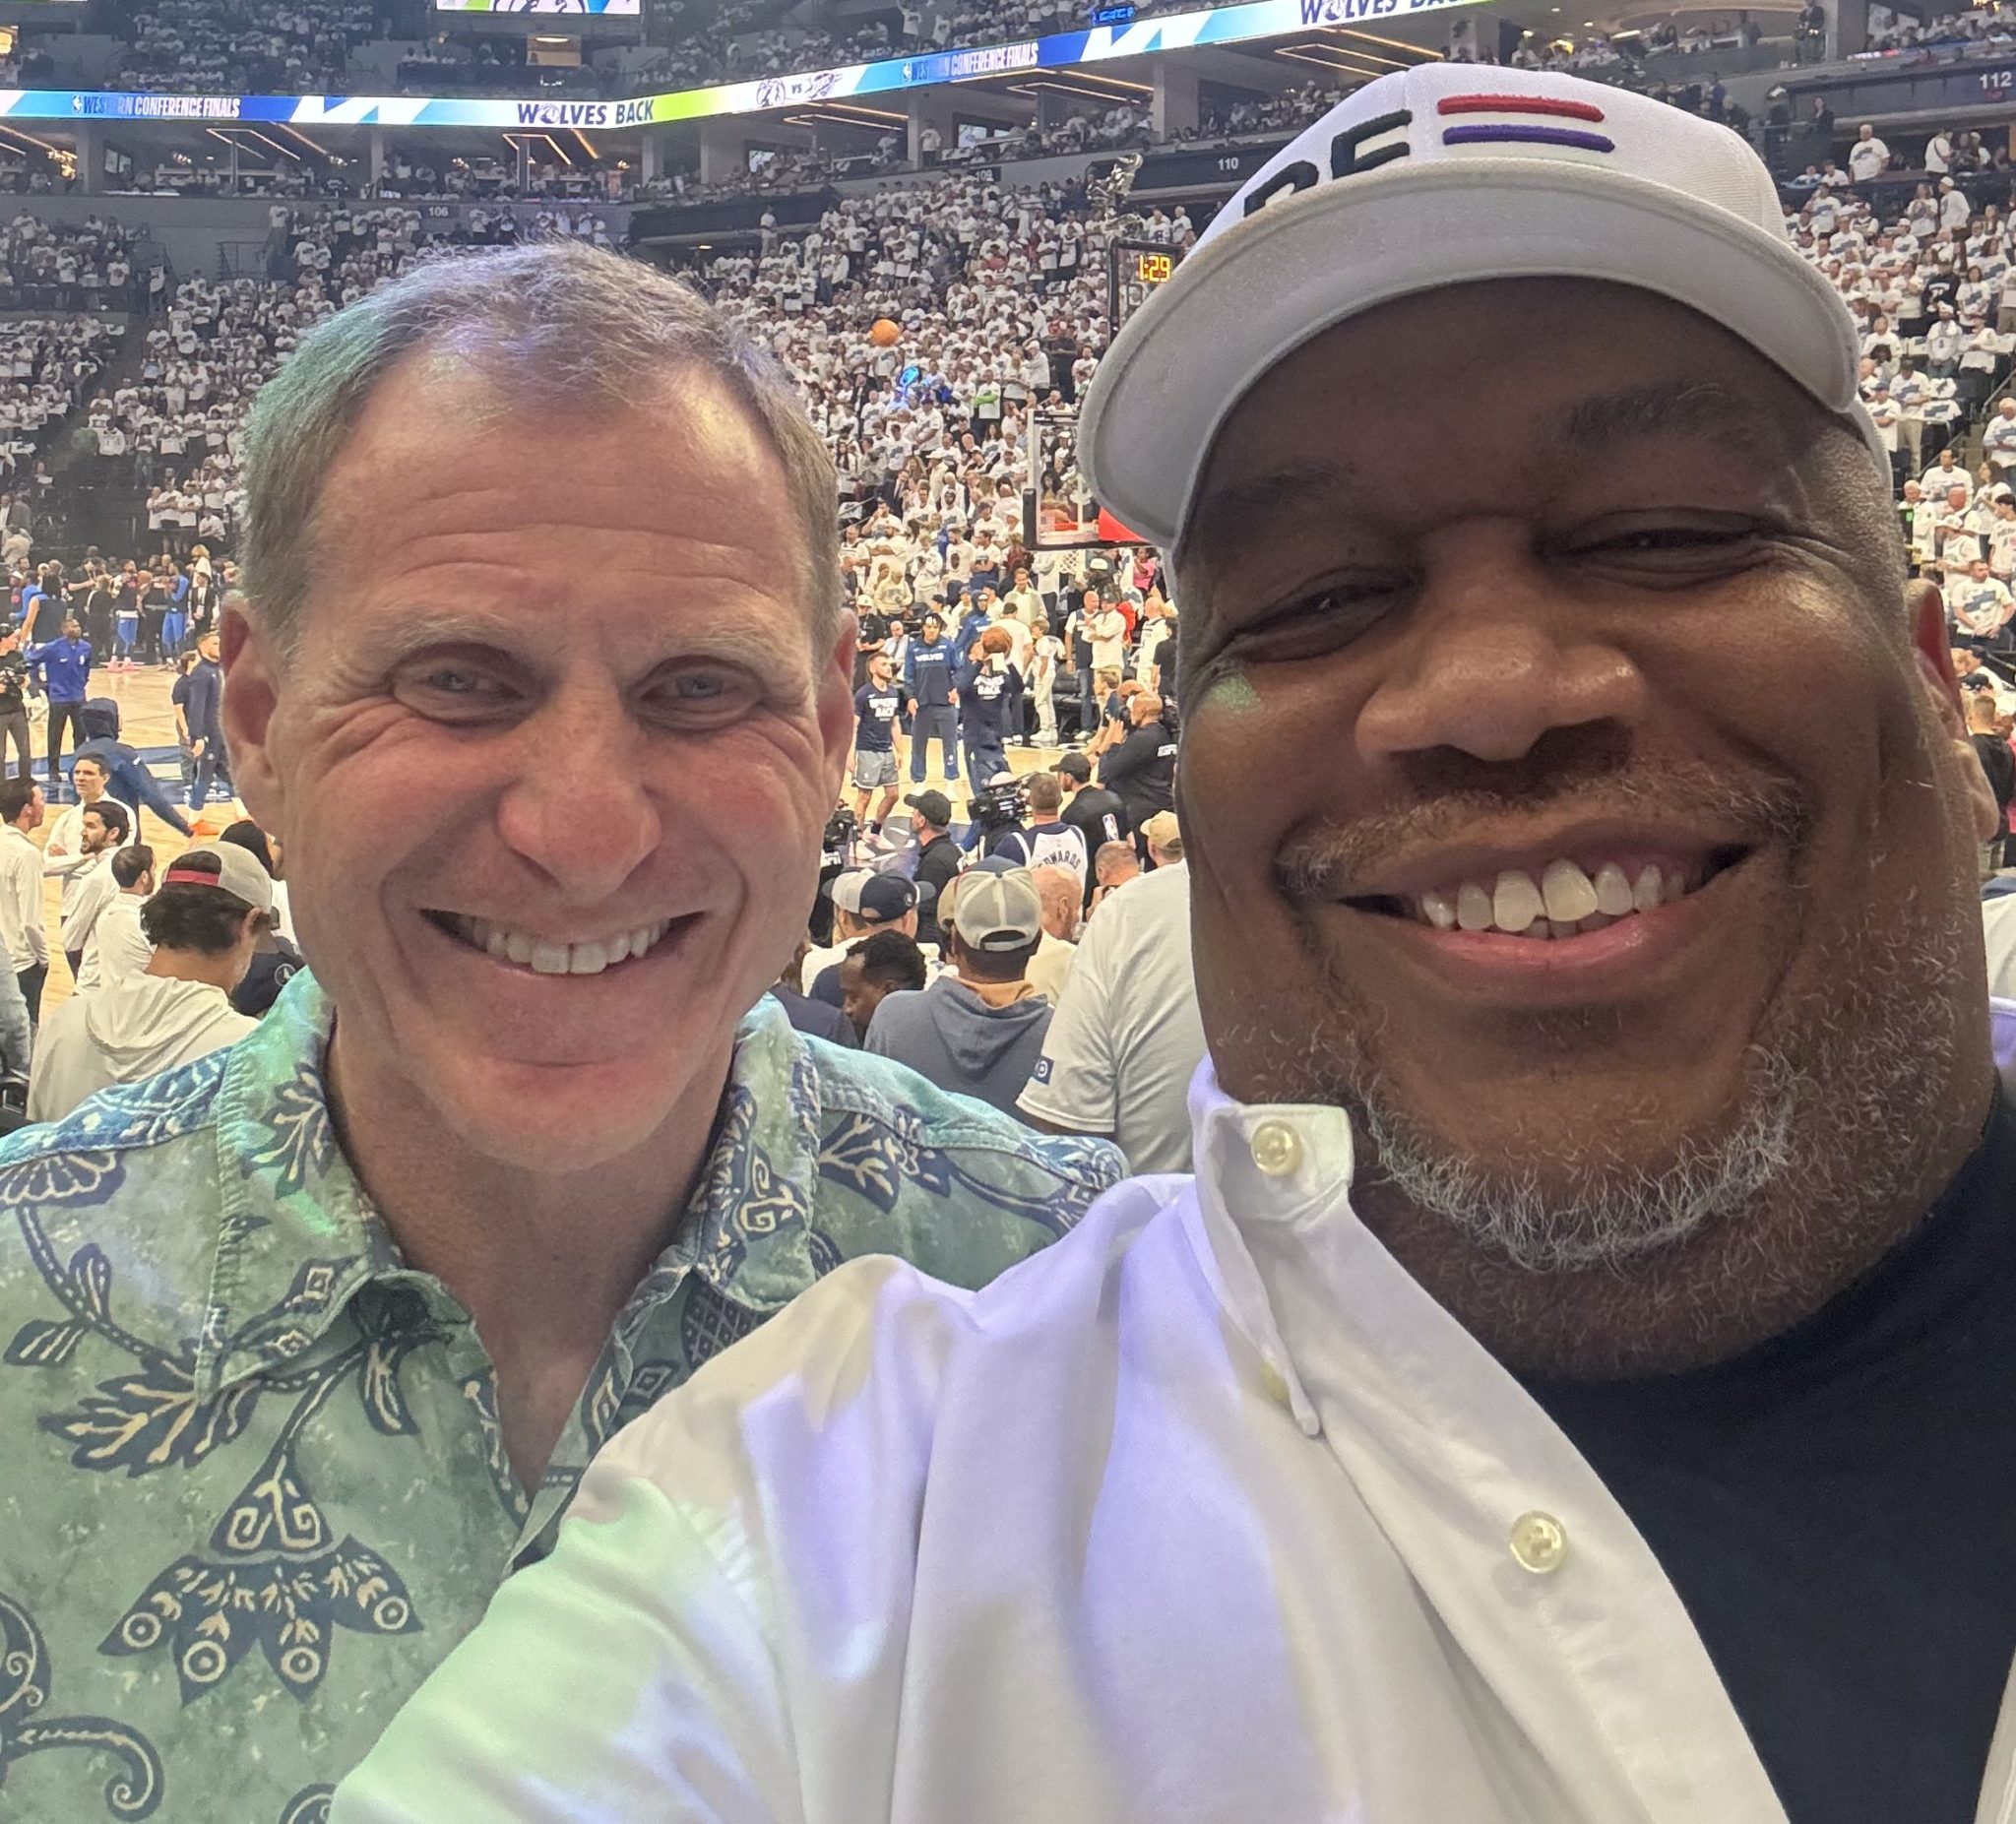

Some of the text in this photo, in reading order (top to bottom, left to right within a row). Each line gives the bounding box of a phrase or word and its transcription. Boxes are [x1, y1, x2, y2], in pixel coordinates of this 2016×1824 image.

[1979, 71, 2012, 89] 112
[135, 96, 203, 117] CONFERENCE
[203, 97, 240, 118] FINALS
[517, 99, 655, 125] WOLVES BACK
[1218, 157, 1239, 170] 110
[428, 207, 449, 217] 106
[1139, 254, 1170, 283] 1:29
